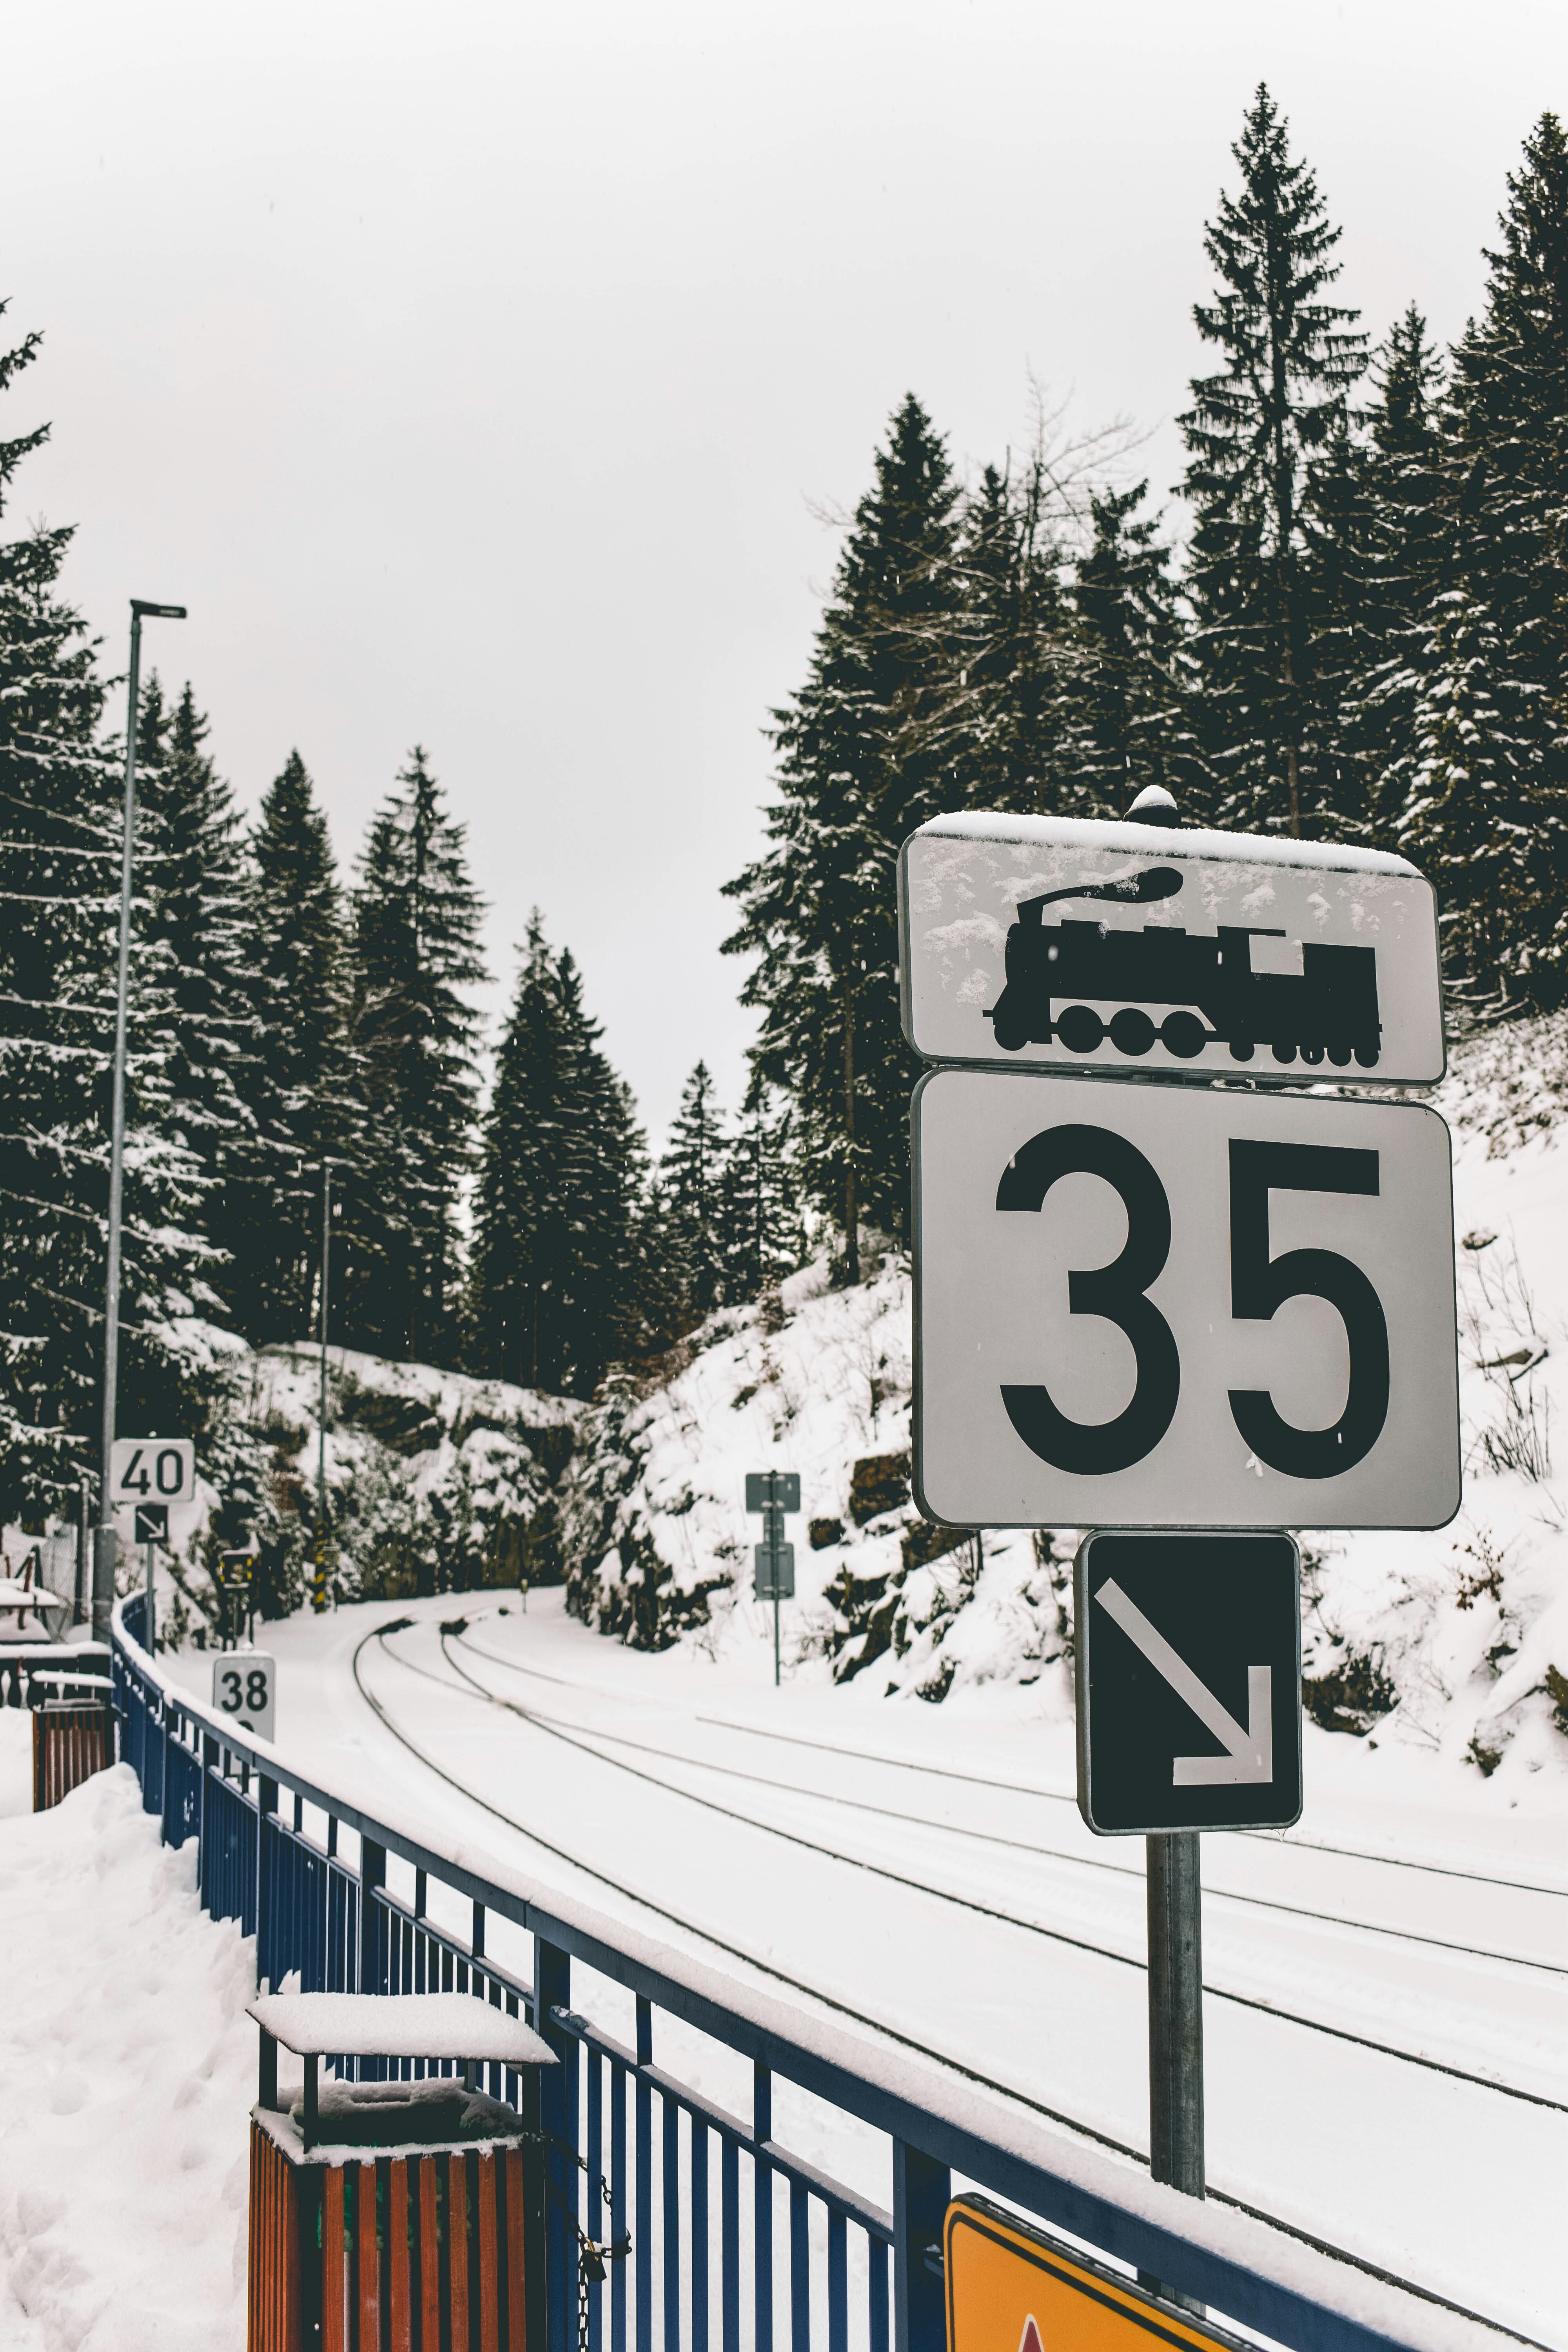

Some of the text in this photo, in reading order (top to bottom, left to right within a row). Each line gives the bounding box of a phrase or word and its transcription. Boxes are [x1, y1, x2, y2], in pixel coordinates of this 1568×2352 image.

[996, 1124, 1390, 1479] 35
[121, 1449, 183, 1495] 40
[221, 1670, 268, 1713] 38
